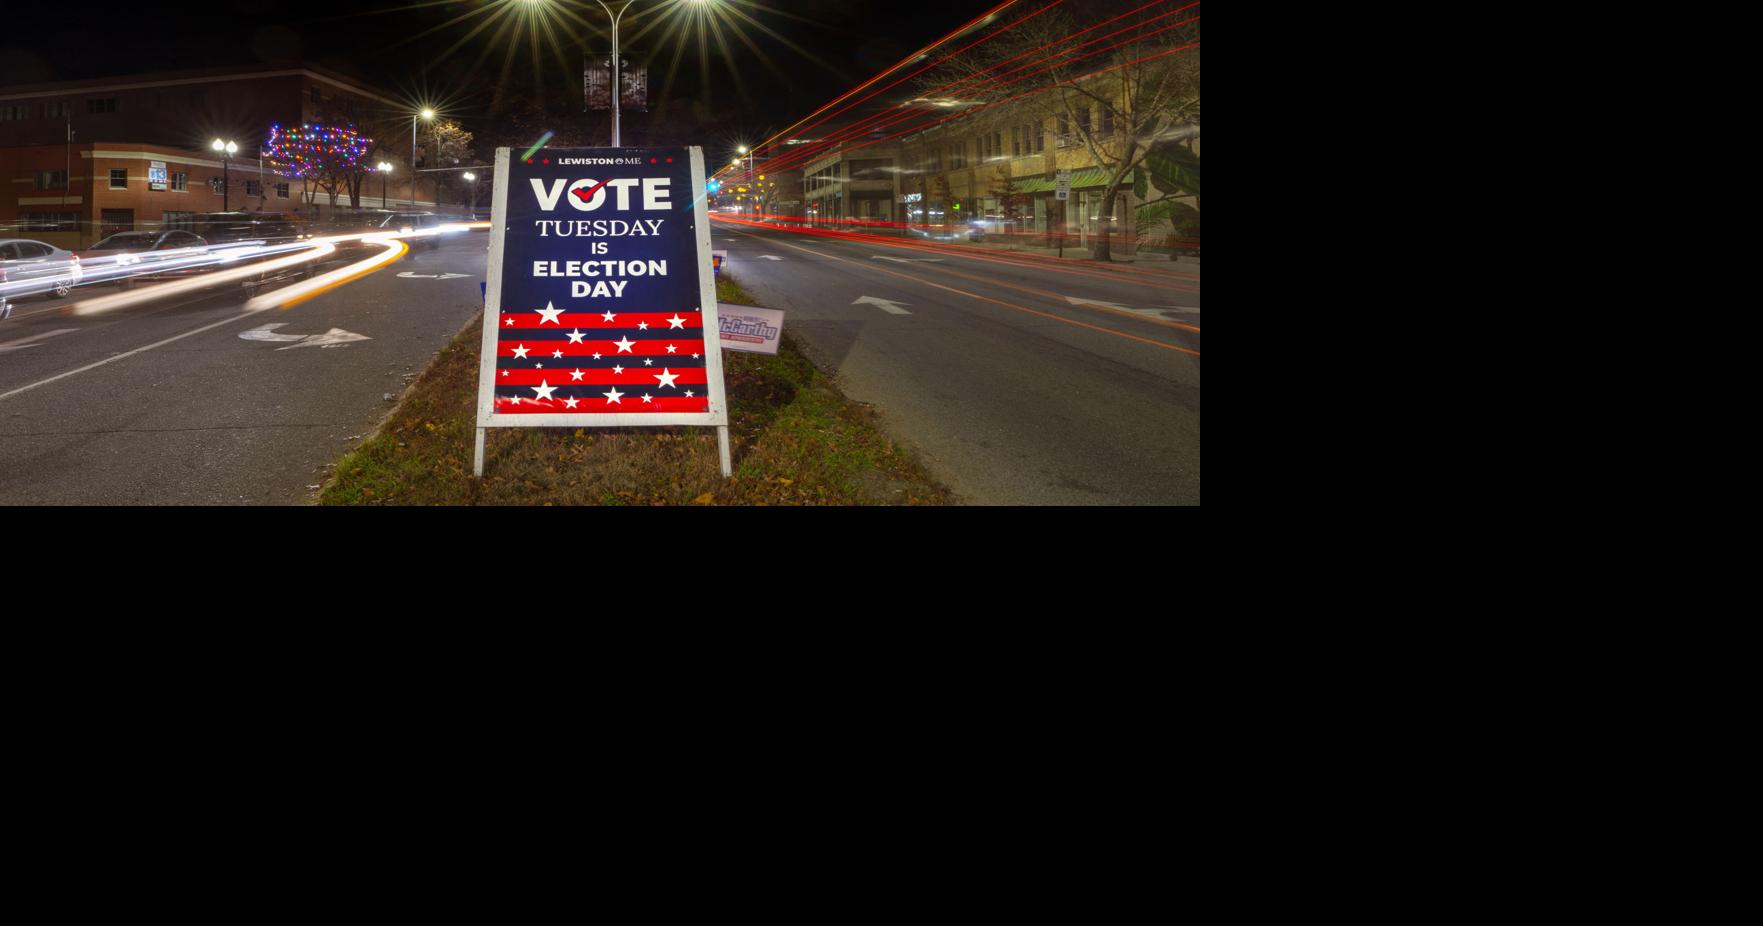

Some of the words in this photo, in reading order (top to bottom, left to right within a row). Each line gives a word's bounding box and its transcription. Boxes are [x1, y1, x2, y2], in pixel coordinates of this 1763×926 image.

[529, 177, 672, 212] VOTE
[535, 219, 664, 237] TUESDAY
[591, 242, 608, 254] IS
[533, 260, 668, 277] ELECTION
[571, 281, 628, 298] DAY
